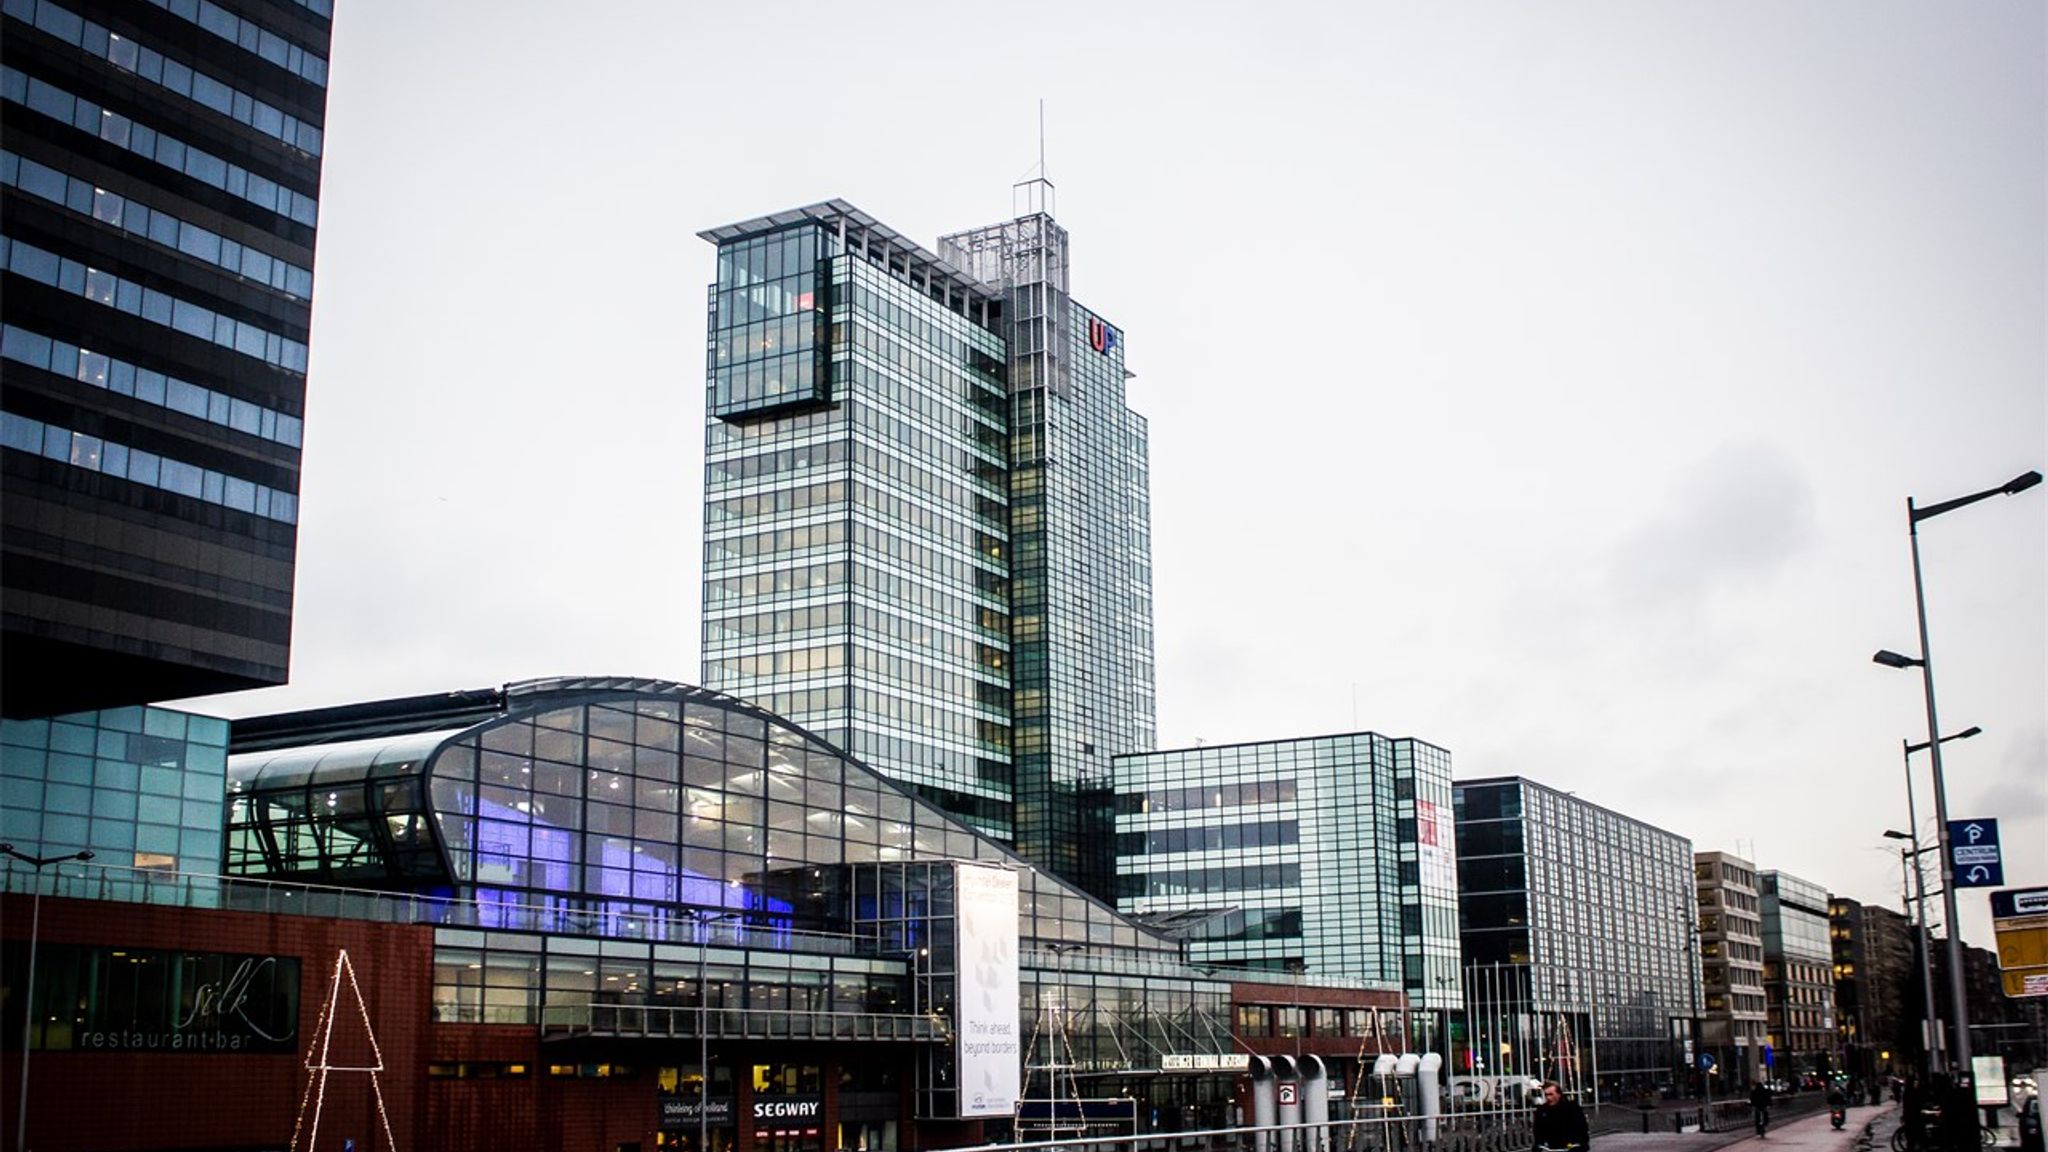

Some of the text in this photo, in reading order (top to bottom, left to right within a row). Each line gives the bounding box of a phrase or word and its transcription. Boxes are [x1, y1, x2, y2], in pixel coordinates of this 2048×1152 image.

[969, 1020, 988, 1034] Think
[964, 1041, 1017, 1057] beyond borders
[753, 1102, 819, 1117] SEGWAY
